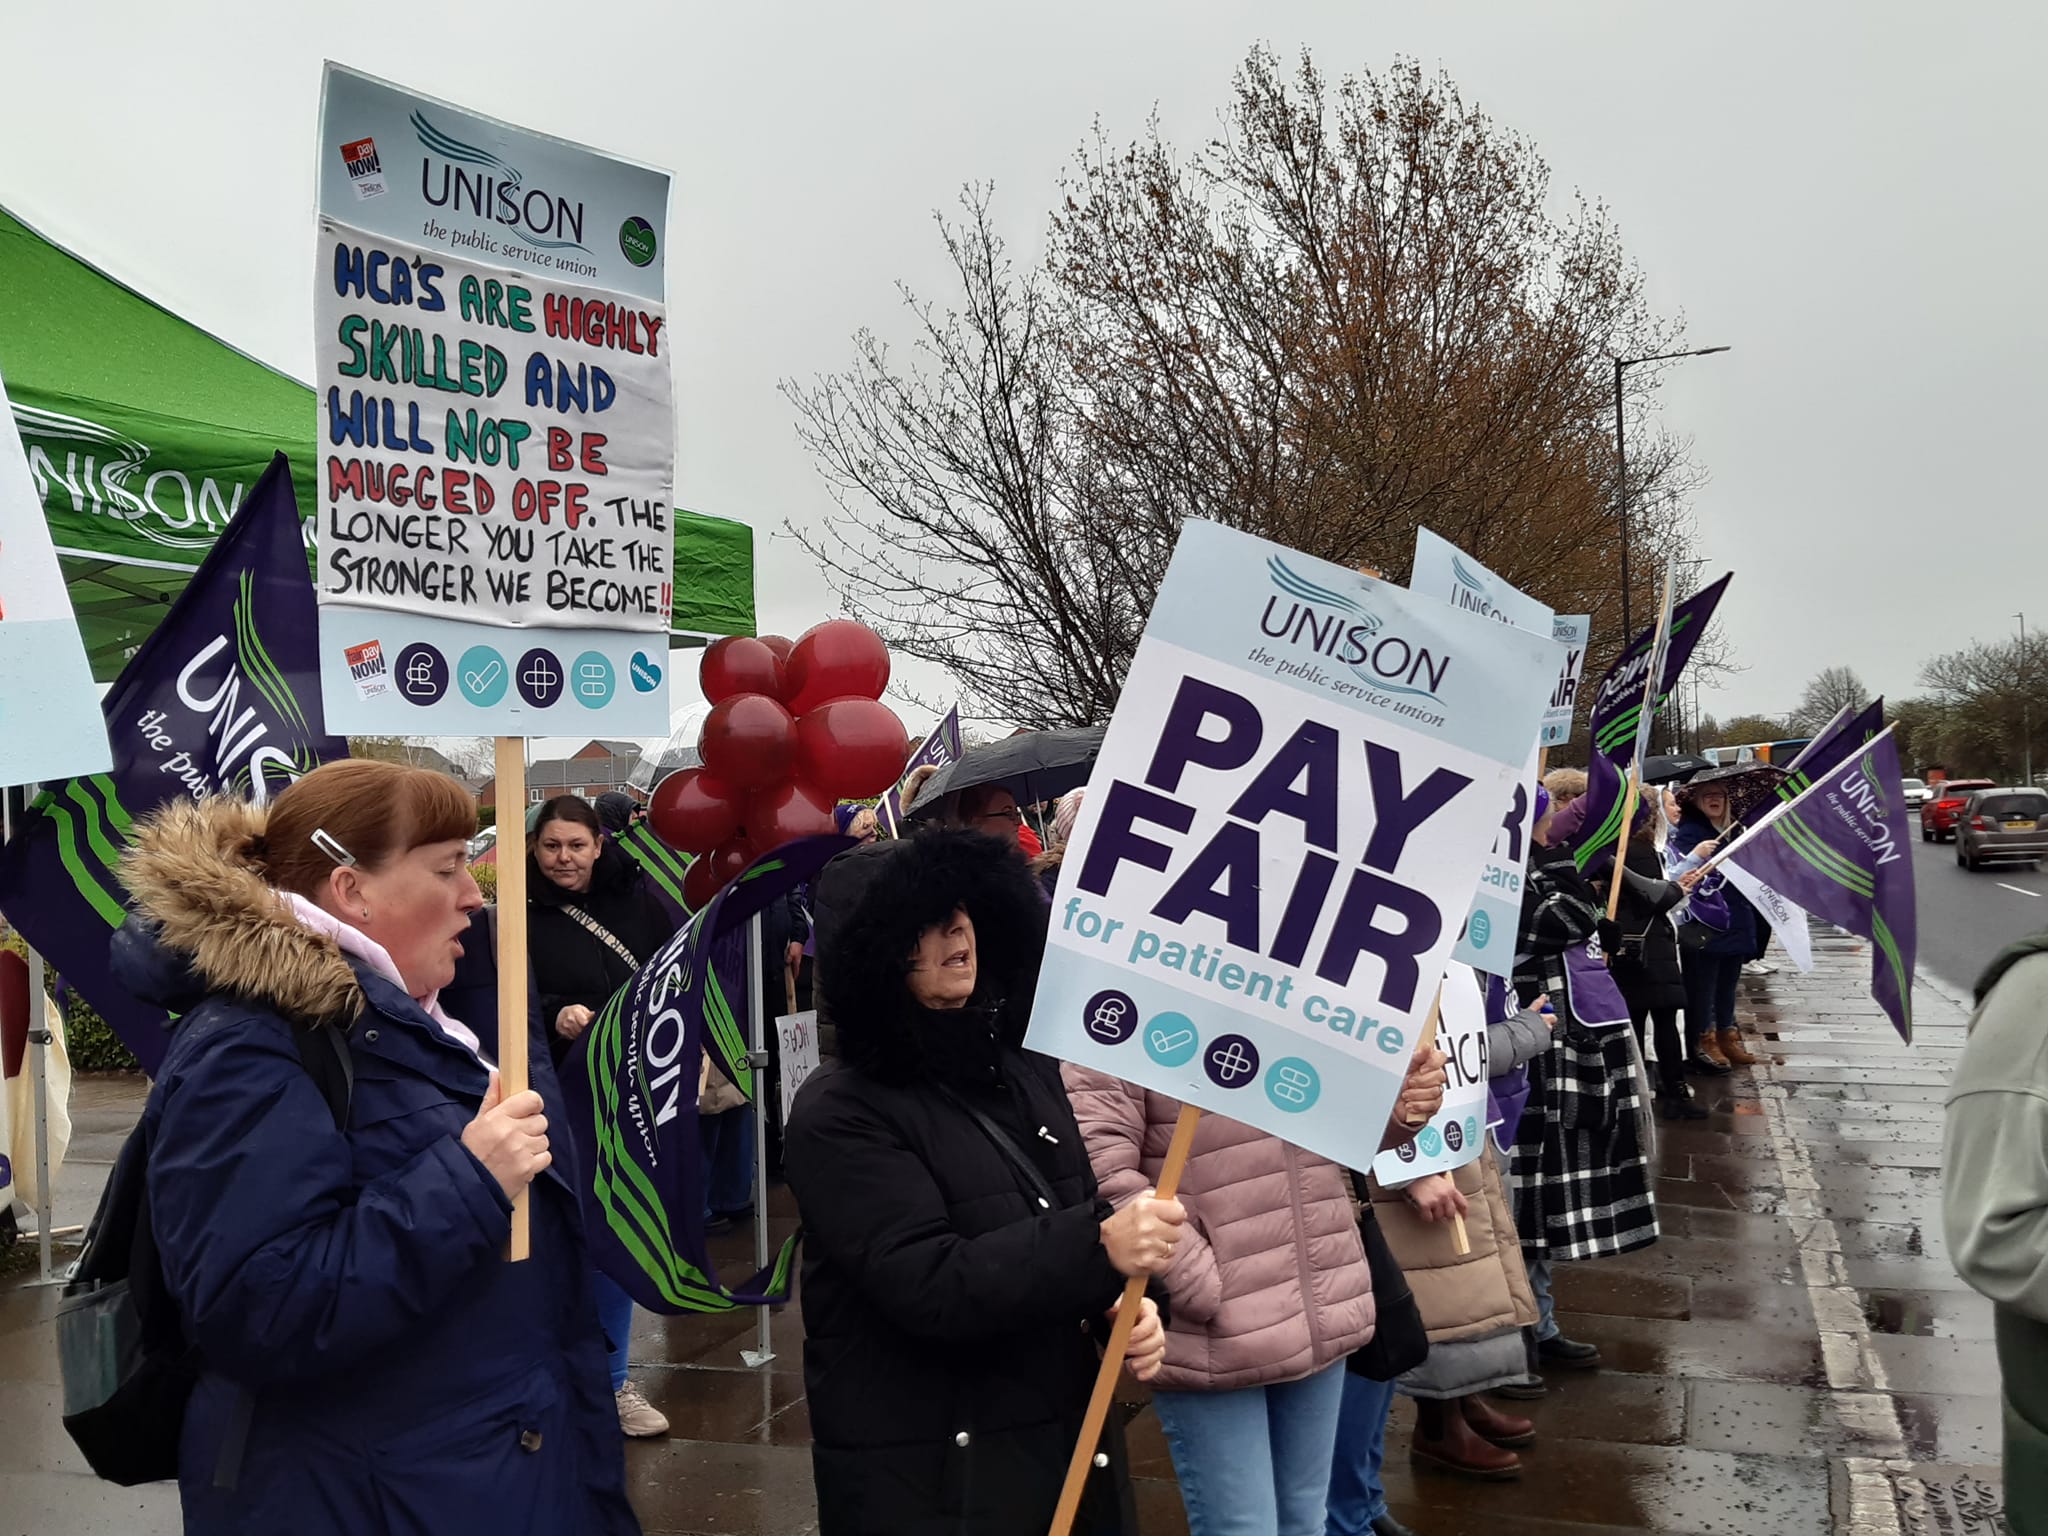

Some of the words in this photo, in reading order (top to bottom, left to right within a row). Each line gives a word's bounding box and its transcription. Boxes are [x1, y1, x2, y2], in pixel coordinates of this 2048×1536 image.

[347, 152, 381, 178] NOW!
[421, 157, 584, 244] UNISON
[423, 218, 447, 241] the
[450, 228, 498, 255] public
[502, 245, 551, 268] service
[555, 257, 597, 279] union
[334, 242, 445, 312] HCA'S
[459, 275, 536, 333] ARE
[543, 292, 663, 358] HIGHLY
[338, 314, 507, 397] SKILLED
[525, 352, 616, 414] AND
[328, 386, 435, 454] WILL
[446, 408, 532, 471] NOT
[547, 426, 608, 476] BE
[327, 456, 495, 515] MUGGED
[512, 478, 597, 530] OFF.
[604, 497, 667, 532] THE
[330, 508, 470, 554] LONGER
[482, 522, 534, 563] YOU
[546, 531, 616, 569] TAKE
[622, 539, 665, 574] THE
[330, 548, 478, 604] STRONGER
[486, 568, 532, 603] WE
[350, 653, 386, 680] NOW!
[362, 645, 379, 661] pay
[632, 662, 657, 687] UNISON
[1260, 596, 1450, 693] UNISON
[1248, 647, 1274, 667] the
[1275, 655, 1328, 687] public
[1332, 680, 1391, 709] service
[1393, 701, 1445, 727] union
[137, 709, 173, 751] the
[1144, 675, 1474, 875] PAY
[1076, 779, 1442, 1014] FAIR
[1063, 897, 1123, 944] for
[1128, 928, 1294, 1009] patient
[1303, 994, 1404, 1054] care
